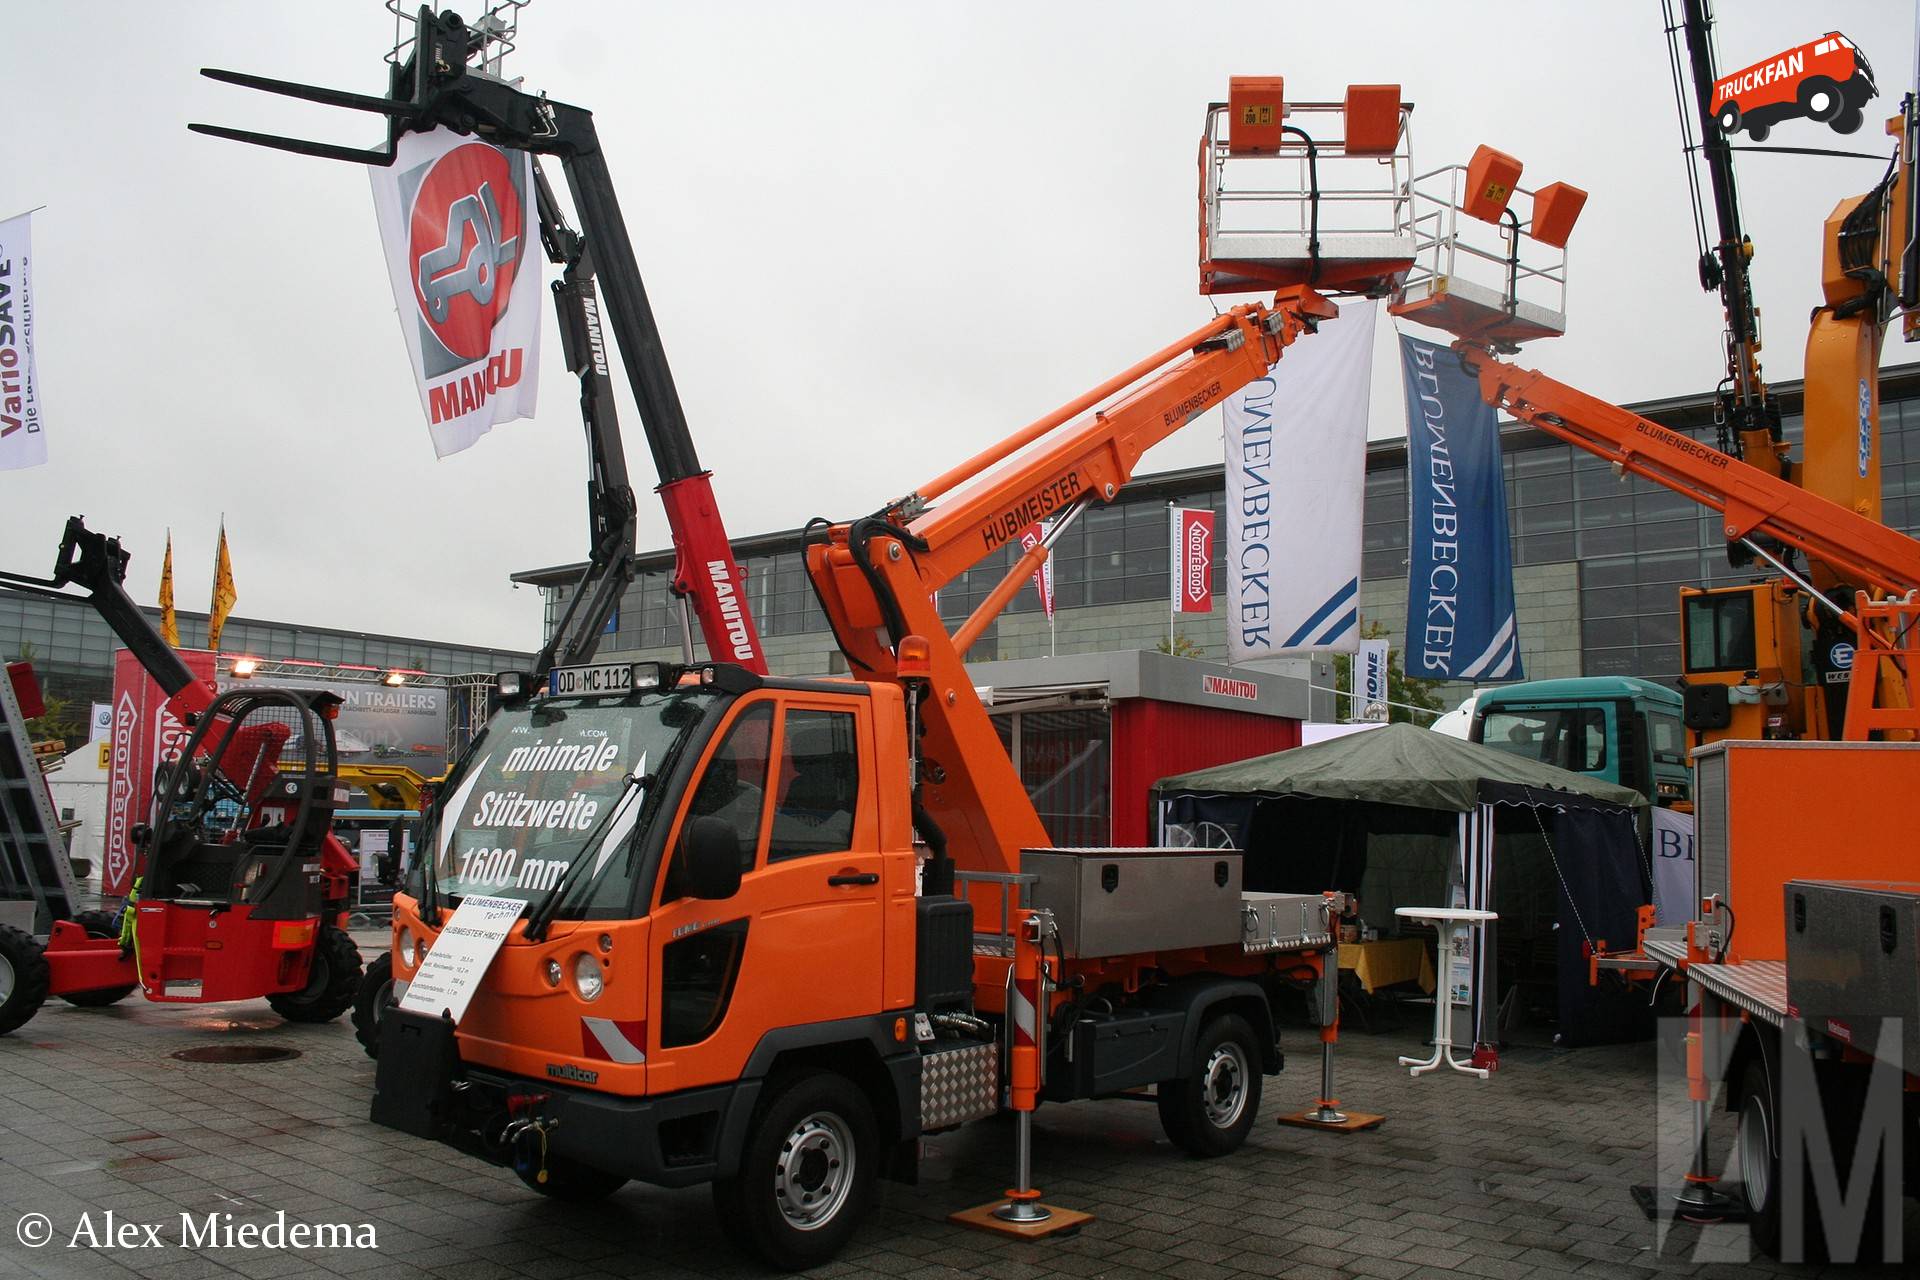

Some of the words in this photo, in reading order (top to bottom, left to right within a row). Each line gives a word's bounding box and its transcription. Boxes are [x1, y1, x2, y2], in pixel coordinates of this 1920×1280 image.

[583, 297, 608, 376] MANITOU
[27, 407, 41, 434] Die
[1164, 381, 1222, 426] BLUMENBECKER
[1635, 422, 1729, 470] BLUMENBECKER
[982, 471, 1082, 551] HUBMEISTER
[1191, 528, 1202, 585] NOOTEBOOM
[707, 560, 754, 660] MANITOU
[558, 676, 575, 692] OD
[583, 670, 600, 690] MC
[604, 667, 630, 689] 112
[1212, 677, 1256, 699] MANITOU
[365, 690, 436, 709] TRAILERS
[502, 738, 619, 772] minimale
[112, 711, 130, 869] NOOTEBOOM
[473, 791, 599, 831] Stützweite
[457, 848, 517, 885] 1600
[464, 896, 524, 912] BLUMENBECKER
[484, 911, 517, 921] Technik
[445, 926, 484, 939] HUBMEISTER
[547, 1064, 598, 1083] multicar
